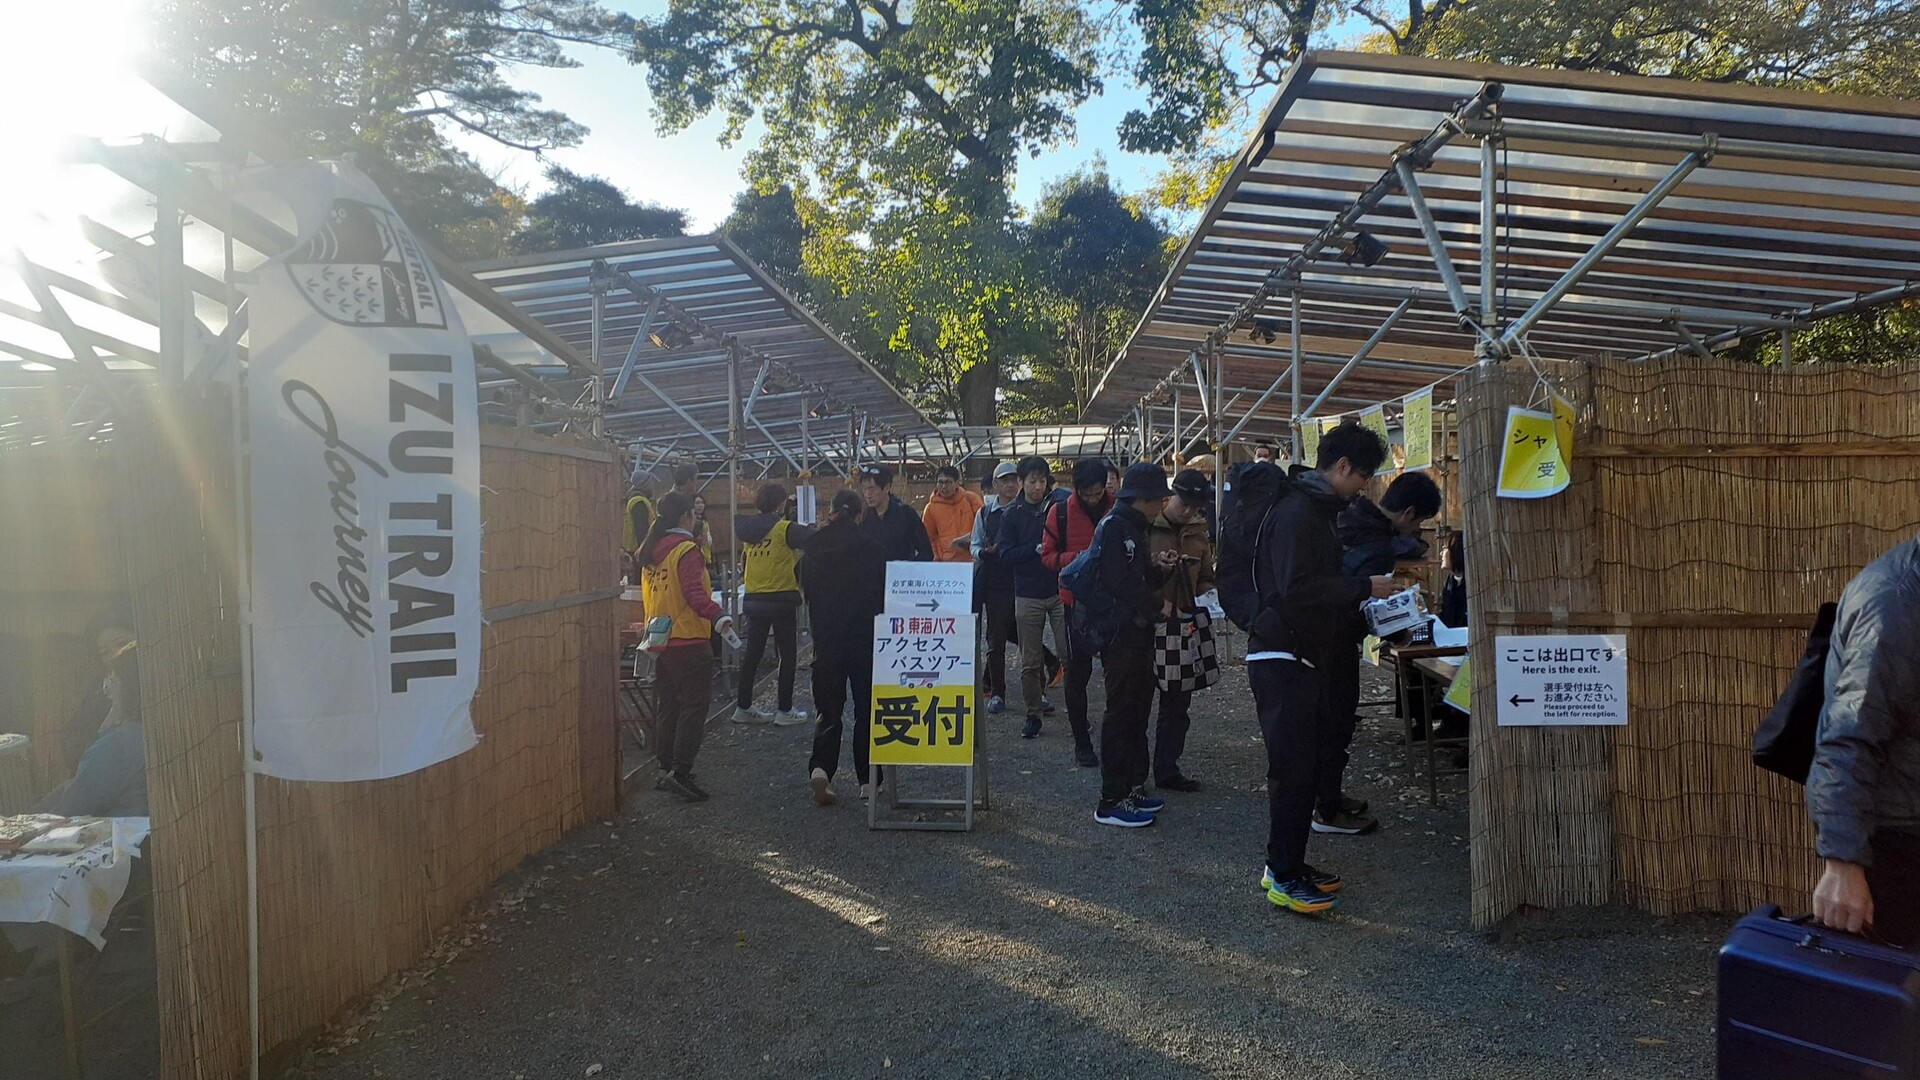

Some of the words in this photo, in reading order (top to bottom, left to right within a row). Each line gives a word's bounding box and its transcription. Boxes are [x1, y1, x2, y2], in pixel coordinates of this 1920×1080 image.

[411, 261, 434, 310] TRAIL
[388, 353, 454, 475] IZU
[281, 379, 389, 638] Journey
[387, 493, 457, 694] TRAIL
[908, 616, 956, 635] 東海バス
[877, 636, 947, 654] アクセス
[891, 655, 972, 671] バスツアー
[1506, 647, 1617, 663] ここは出口です
[1522, 665, 1546, 674] Here
[1548, 665, 1557, 674] is
[1559, 665, 1576, 674] the
[1577, 665, 1601, 674] exit.
[1543, 682, 1614, 693] 選手受付は左へ
[1543, 693, 1618, 703] お進みください。
[1567, 703, 1596, 711] proceed
[1581, 711, 1618, 719] reception.
[873, 695, 971, 746] 受付
